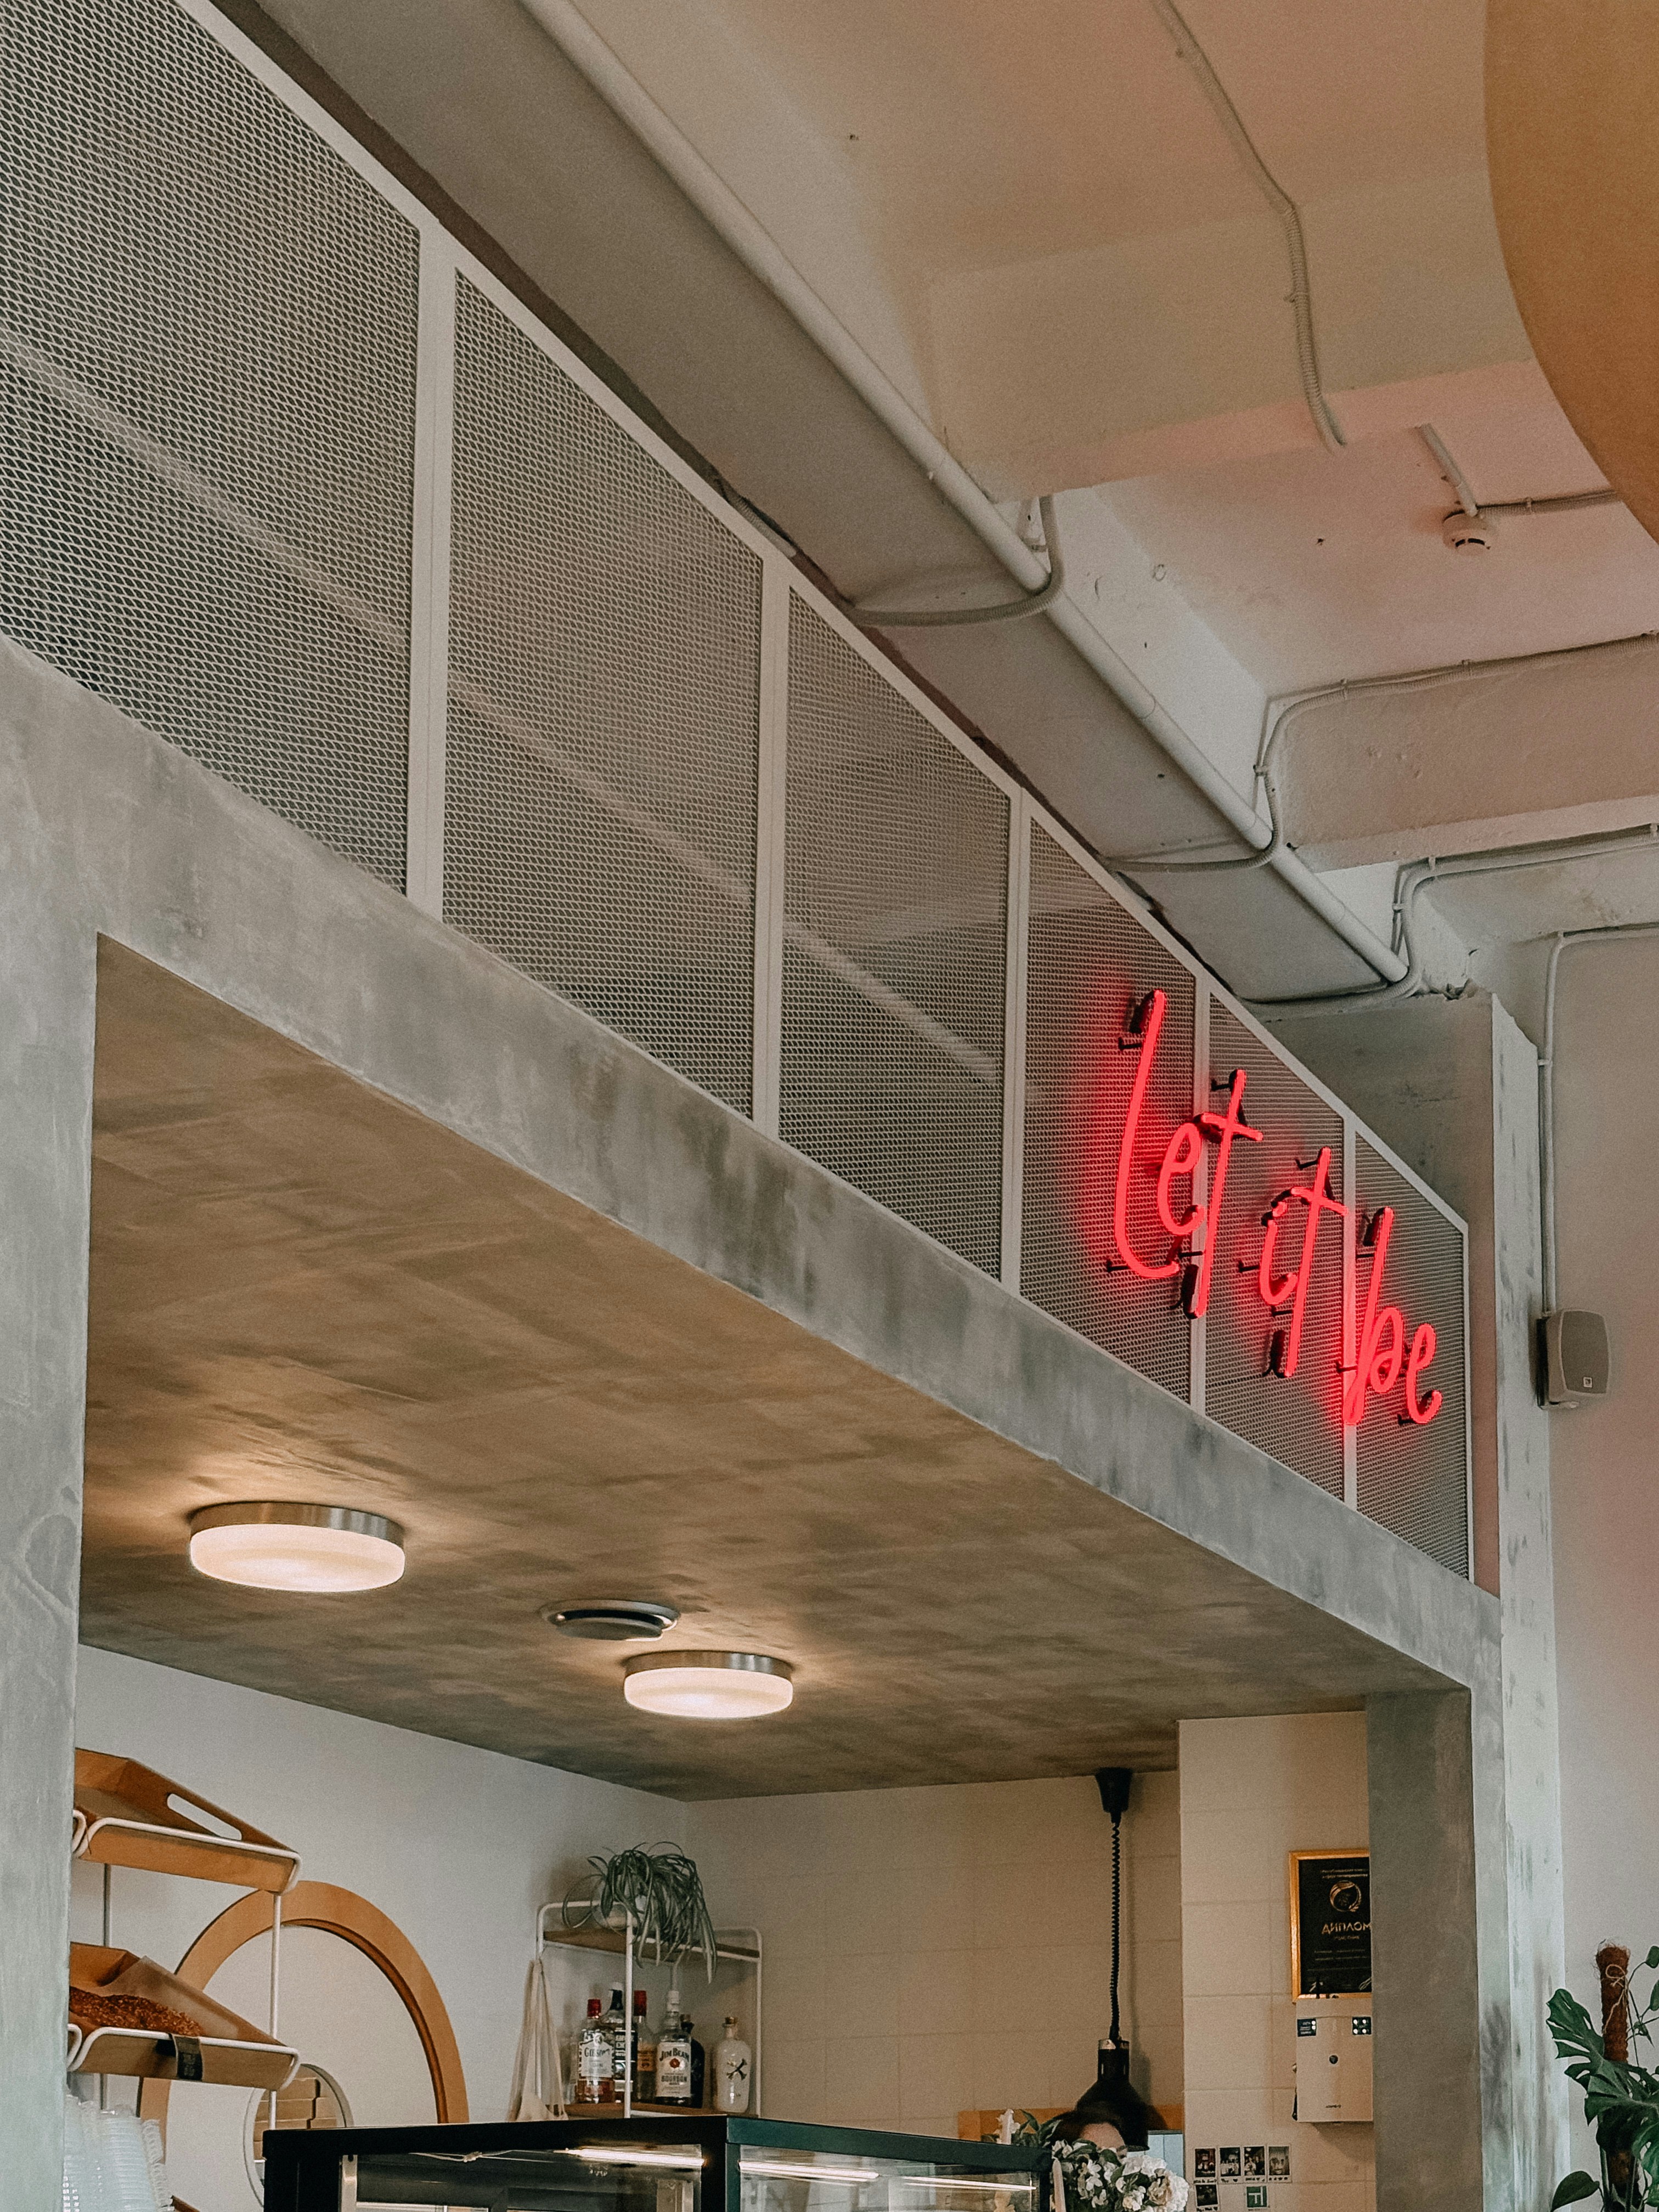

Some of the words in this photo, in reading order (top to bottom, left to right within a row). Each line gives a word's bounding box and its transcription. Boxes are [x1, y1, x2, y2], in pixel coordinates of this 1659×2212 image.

[1259, 1147, 1349, 1378] it
[1342, 1206, 1443, 1425] be
[1321, 1921, 1371, 1934] ДИПЛОМ
